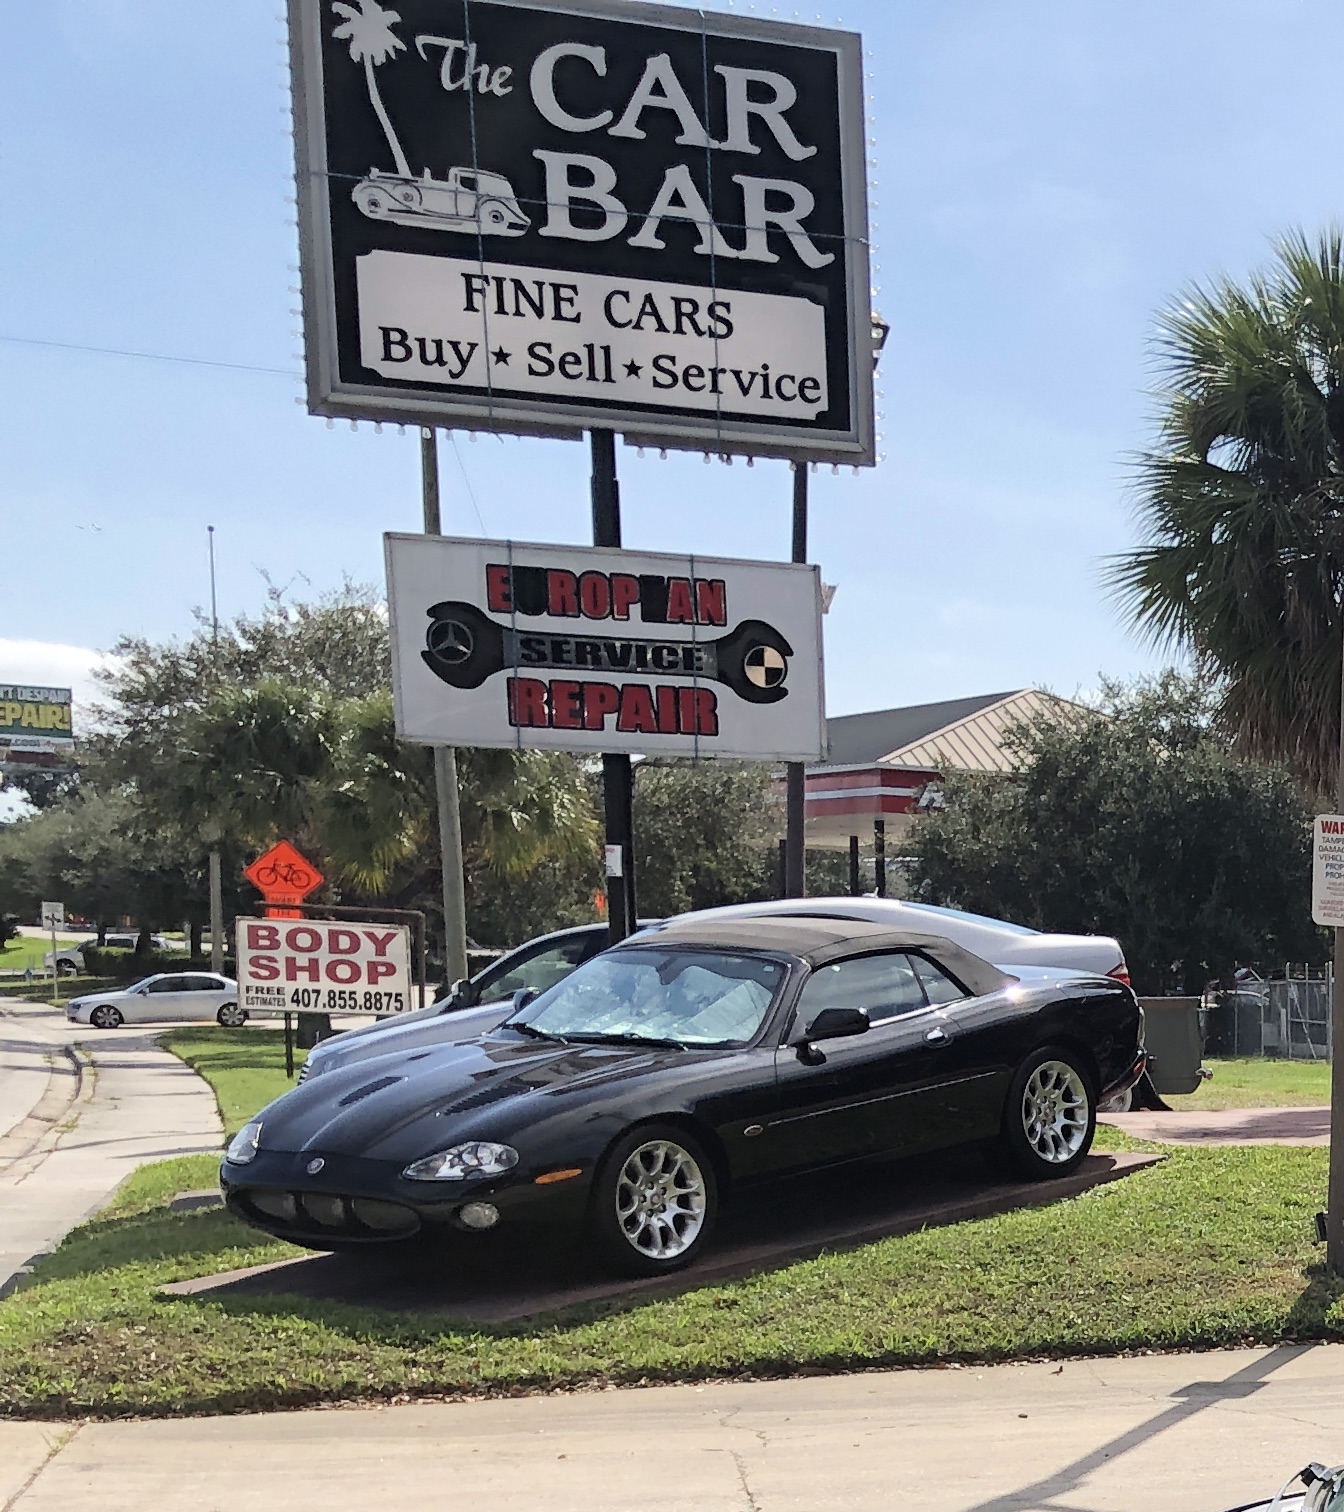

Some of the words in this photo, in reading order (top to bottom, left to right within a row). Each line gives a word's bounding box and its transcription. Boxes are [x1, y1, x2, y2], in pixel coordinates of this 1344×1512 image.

[415, 35, 514, 97] The
[529, 41, 819, 162] CAR
[532, 147, 836, 270] BAR
[460, 272, 582, 324] FINE
[603, 289, 735, 340] CARS
[378, 327, 478, 380] Buy
[527, 341, 616, 385] Sell
[652, 353, 822, 404] Service
[485, 563, 728, 627] EROPAN
[519, 636, 705, 673] SERVICE
[506, 677, 719, 736] REPAIR
[247, 924, 398, 957] BODY
[245, 985, 286, 996] FREE
[247, 955, 397, 985] SHOP
[245, 995, 286, 1007] ESTIMATES
[291, 988, 404, 1011] 407.855.8875
